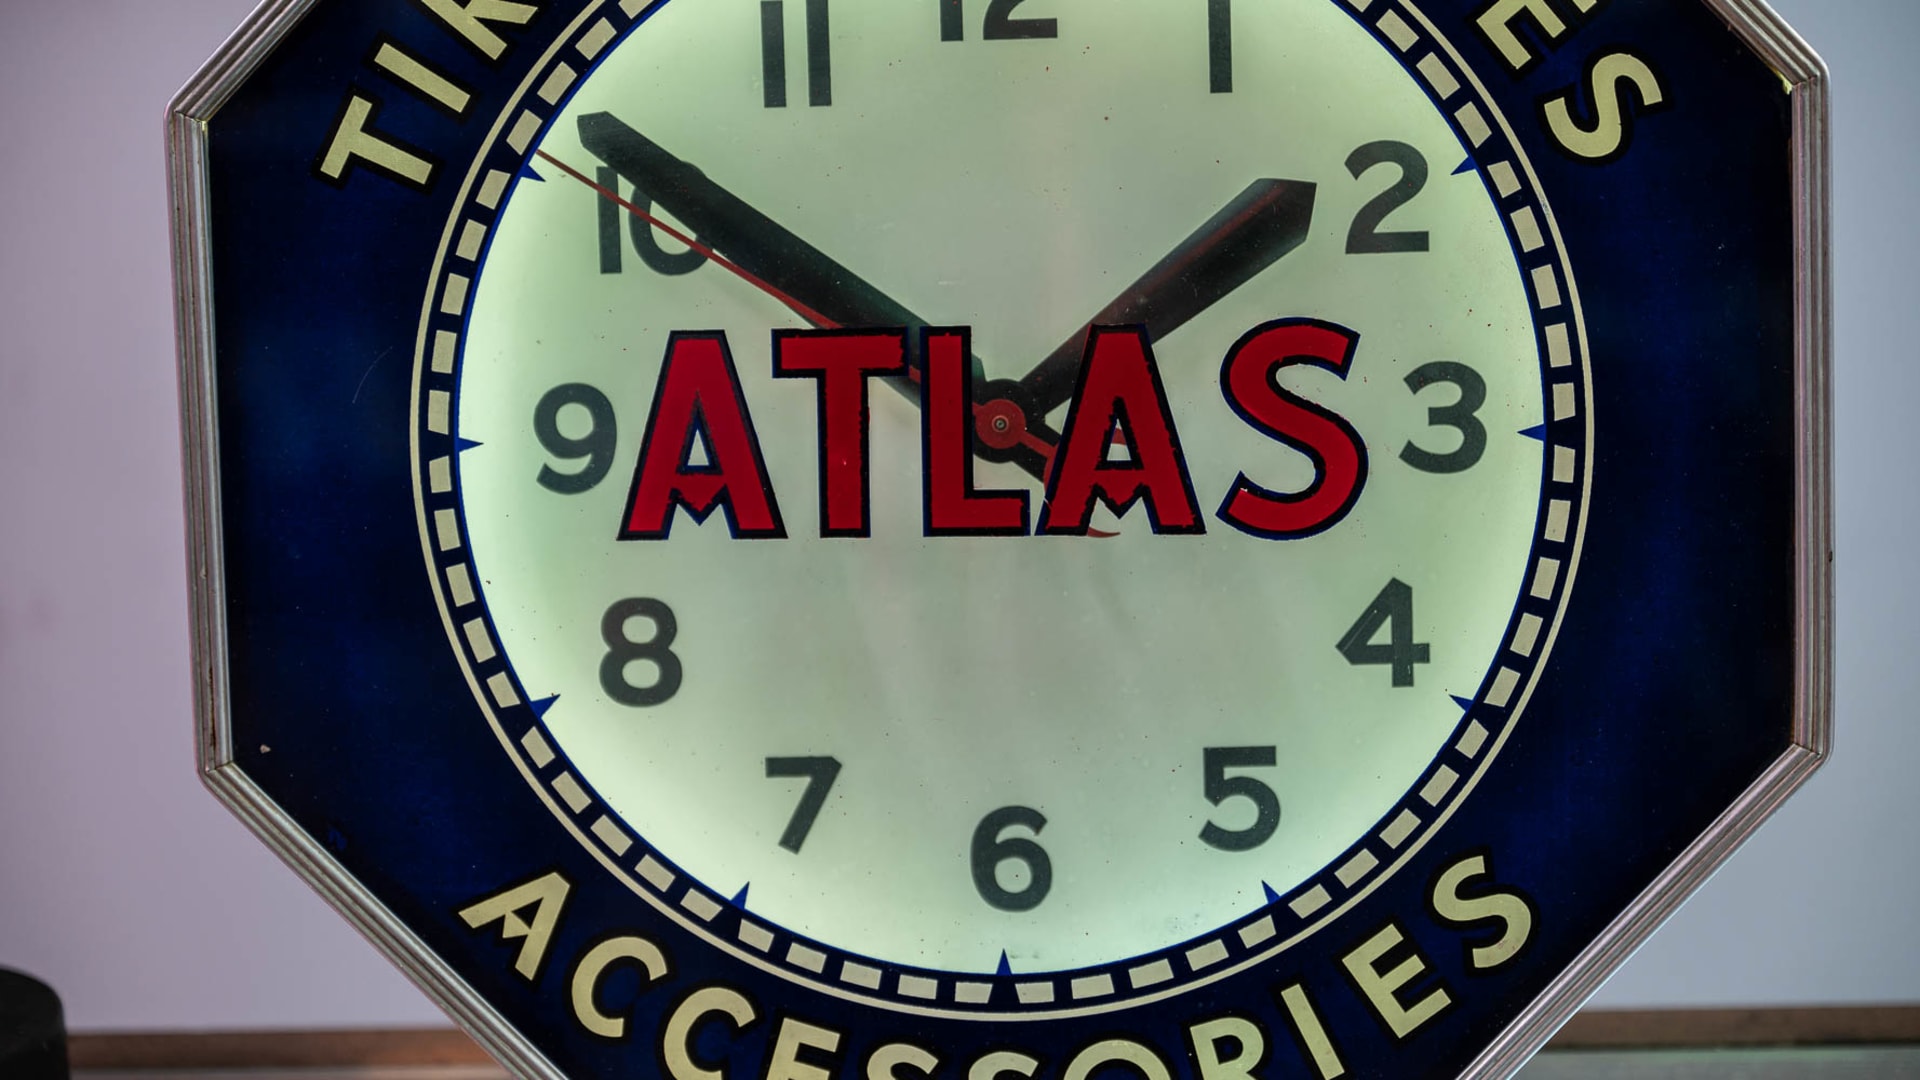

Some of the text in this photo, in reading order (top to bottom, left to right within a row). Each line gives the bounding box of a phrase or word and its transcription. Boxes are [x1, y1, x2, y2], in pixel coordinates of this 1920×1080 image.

[760, 0, 832, 108] 11
[1207, 0, 1233, 94] 1
[1343, 139, 1431, 255] 2
[533, 382, 618, 495] 9
[616, 316, 1369, 541] ATLAS
[1398, 360, 1488, 475] 3
[598, 596, 683, 708] 8
[1335, 576, 1431, 688] 4
[764, 755, 843, 855] 7
[1198, 745, 1282, 852] 5
[969, 805, 1053, 912] 6
[457, 855, 1532, 1080] ACCERIES
